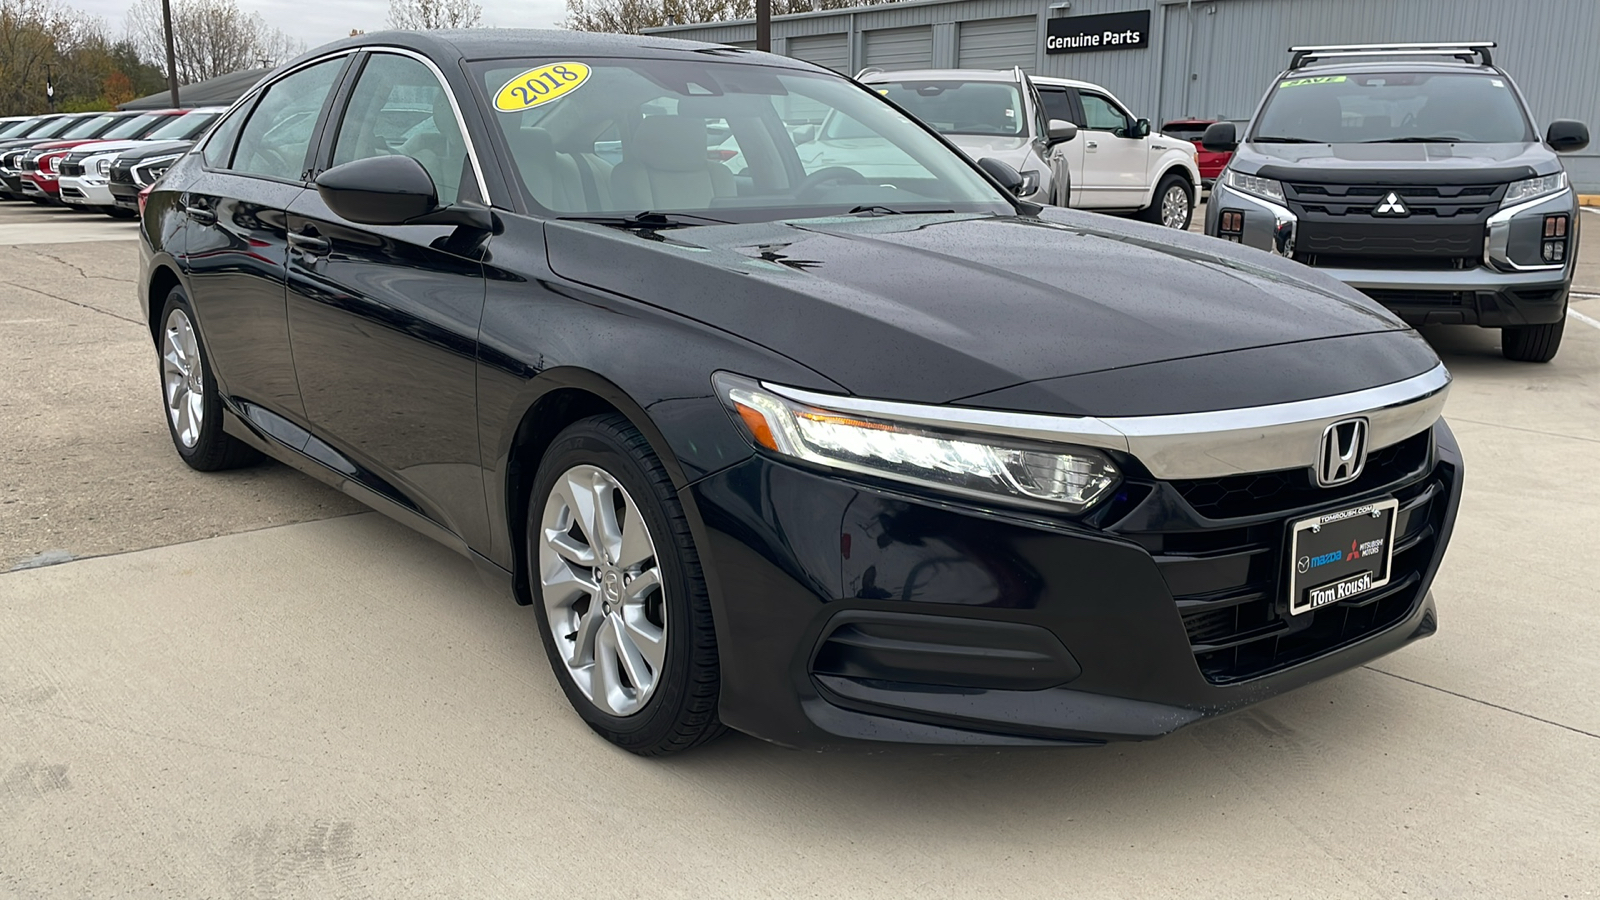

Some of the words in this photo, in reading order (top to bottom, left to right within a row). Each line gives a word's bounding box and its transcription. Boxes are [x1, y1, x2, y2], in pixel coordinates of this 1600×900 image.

[1047, 33, 1100, 49] Genuine
[1103, 30, 1140, 45] Parts
[511, 65, 578, 105] 2018
[1311, 590, 1336, 607] Tom
[1337, 574, 1371, 599] Roush
